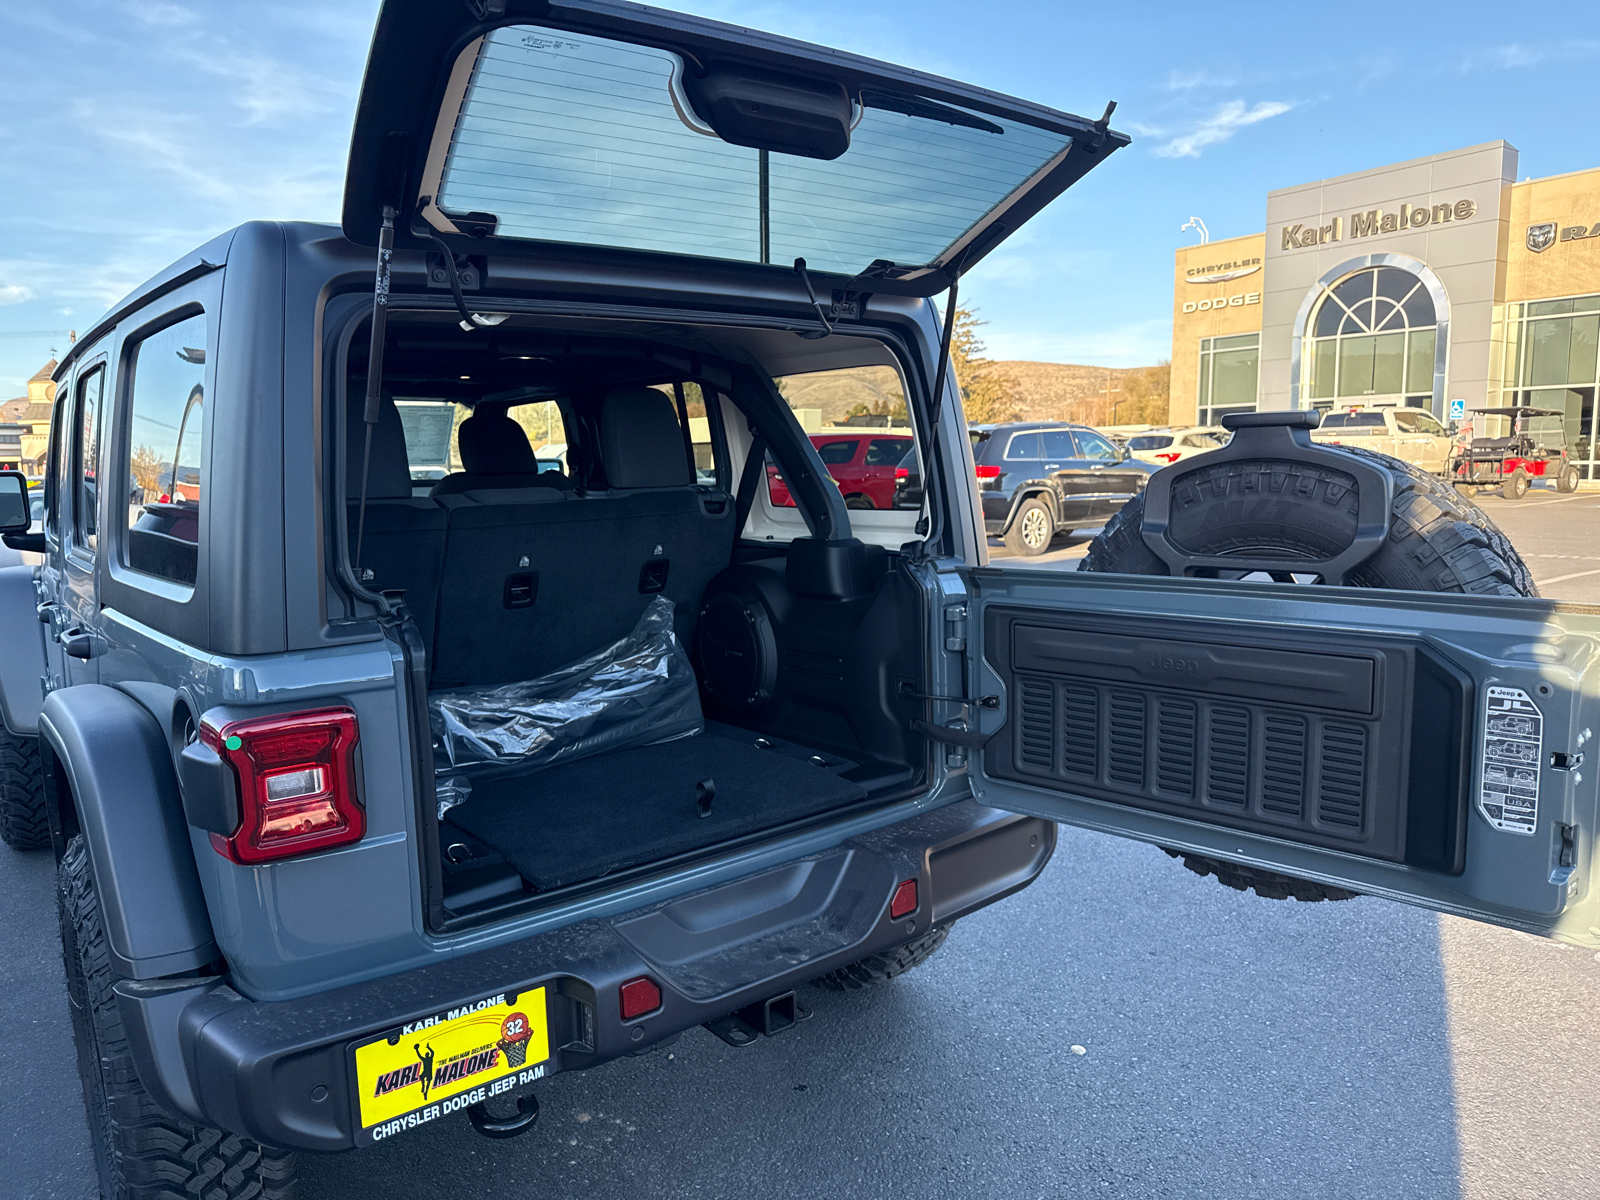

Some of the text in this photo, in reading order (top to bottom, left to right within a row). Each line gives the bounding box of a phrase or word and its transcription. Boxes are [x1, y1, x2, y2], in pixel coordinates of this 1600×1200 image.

[1281, 199, 1477, 250] Karl Malone
[1187, 258, 1261, 276] CHRYSLER
[1182, 292, 1260, 314] DODGE
[1149, 652, 1199, 676] Jeep
[1489, 699, 1534, 711] JL
[1497, 689, 1516, 698] Jeep
[402, 993, 505, 1036] KARL MALONE
[506, 1018, 524, 1036] 32
[374, 1047, 500, 1098] KARL MALONE
[372, 1065, 545, 1141] CHRYSLER DODGE JEEP RAM
